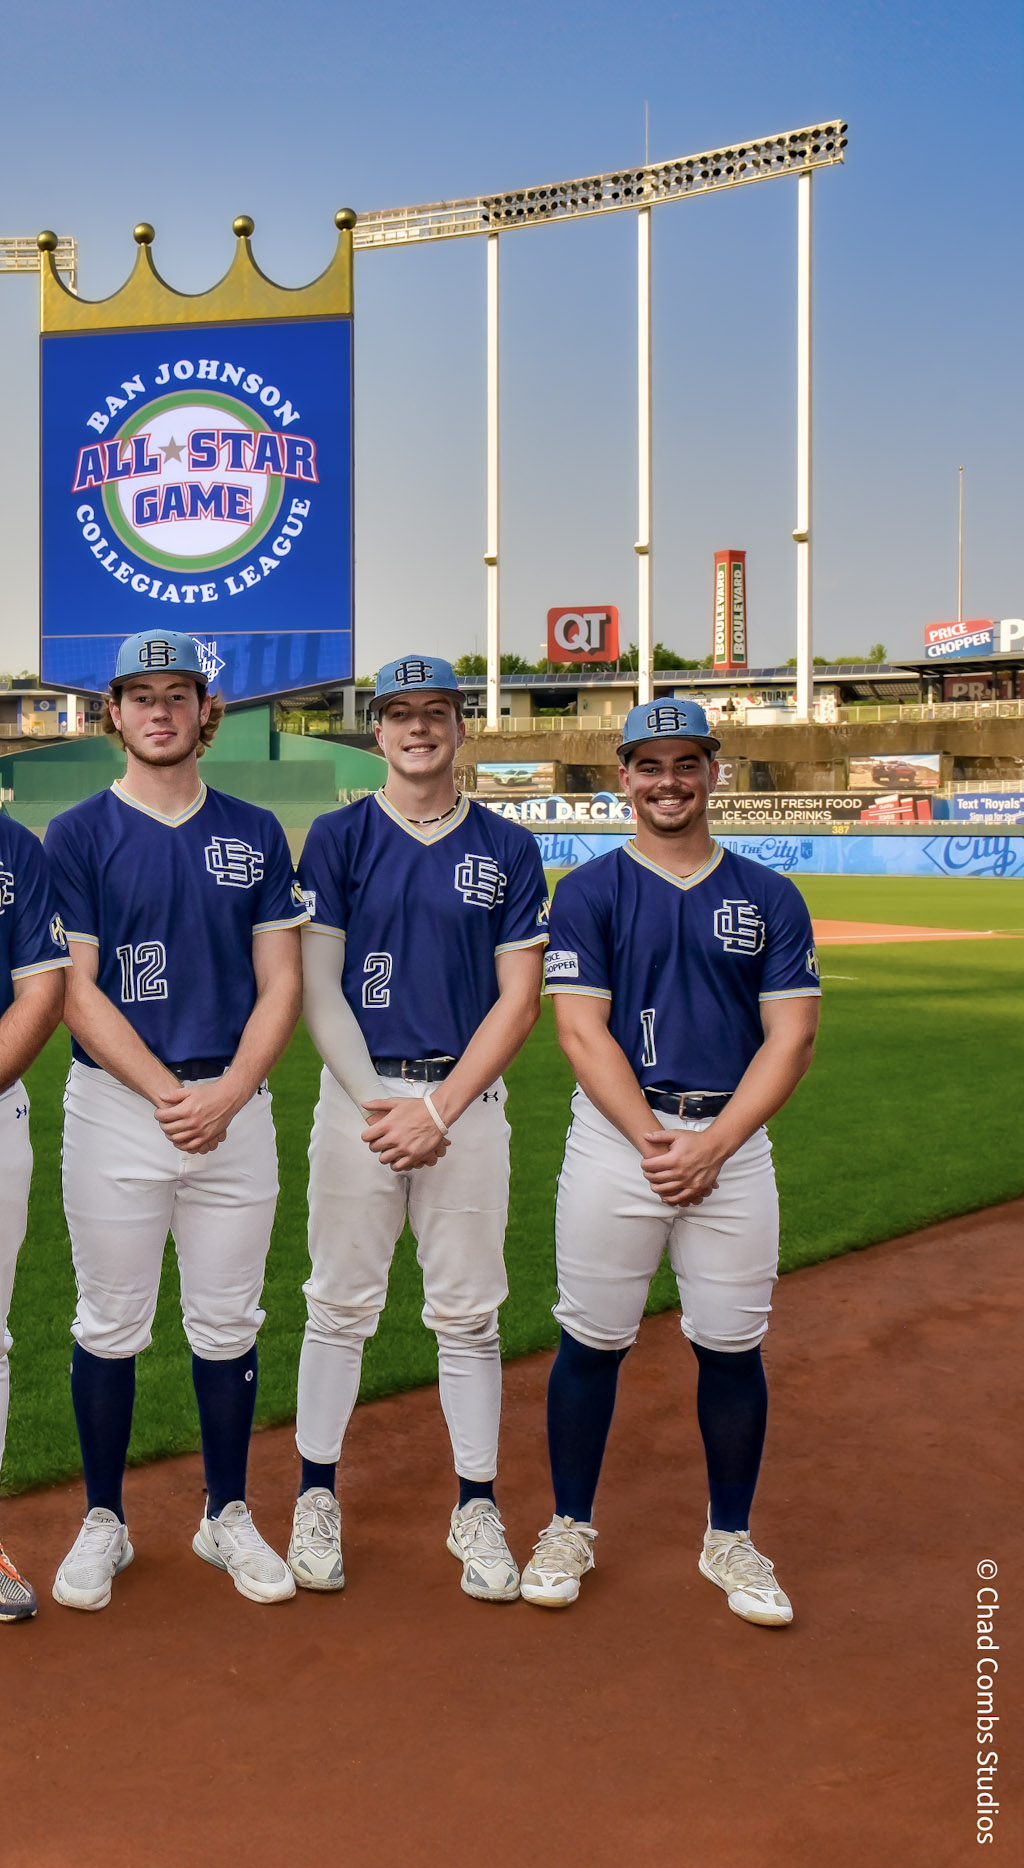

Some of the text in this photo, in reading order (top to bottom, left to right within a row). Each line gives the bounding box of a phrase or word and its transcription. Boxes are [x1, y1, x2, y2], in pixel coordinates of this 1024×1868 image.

[86, 359, 300, 434] BAN JOHNSON
[71, 429, 320, 493] ALL STAR
[133, 481, 252, 527] GAME
[76, 498, 311, 604] COLLEGIATE LEAGUE
[554, 612, 610, 652] QT
[716, 570, 725, 655] BOULEVARD
[734, 569, 744, 655] BOULEVARD
[929, 623, 968, 642] PRICE
[928, 632, 992, 657] CHOPPER
[556, 802, 627, 820] DECK
[707, 798, 863, 809] EAT VIEWS FRESH FOOD
[722, 811, 832, 820] ICE-COLD DRINKS
[957, 798, 979, 809] Text
[832, 825, 850, 834] 387
[757, 838, 798, 871] City
[116, 940, 168, 1003] 12
[362, 952, 392, 1008] 2
[641, 1008, 656, 1067] 1
